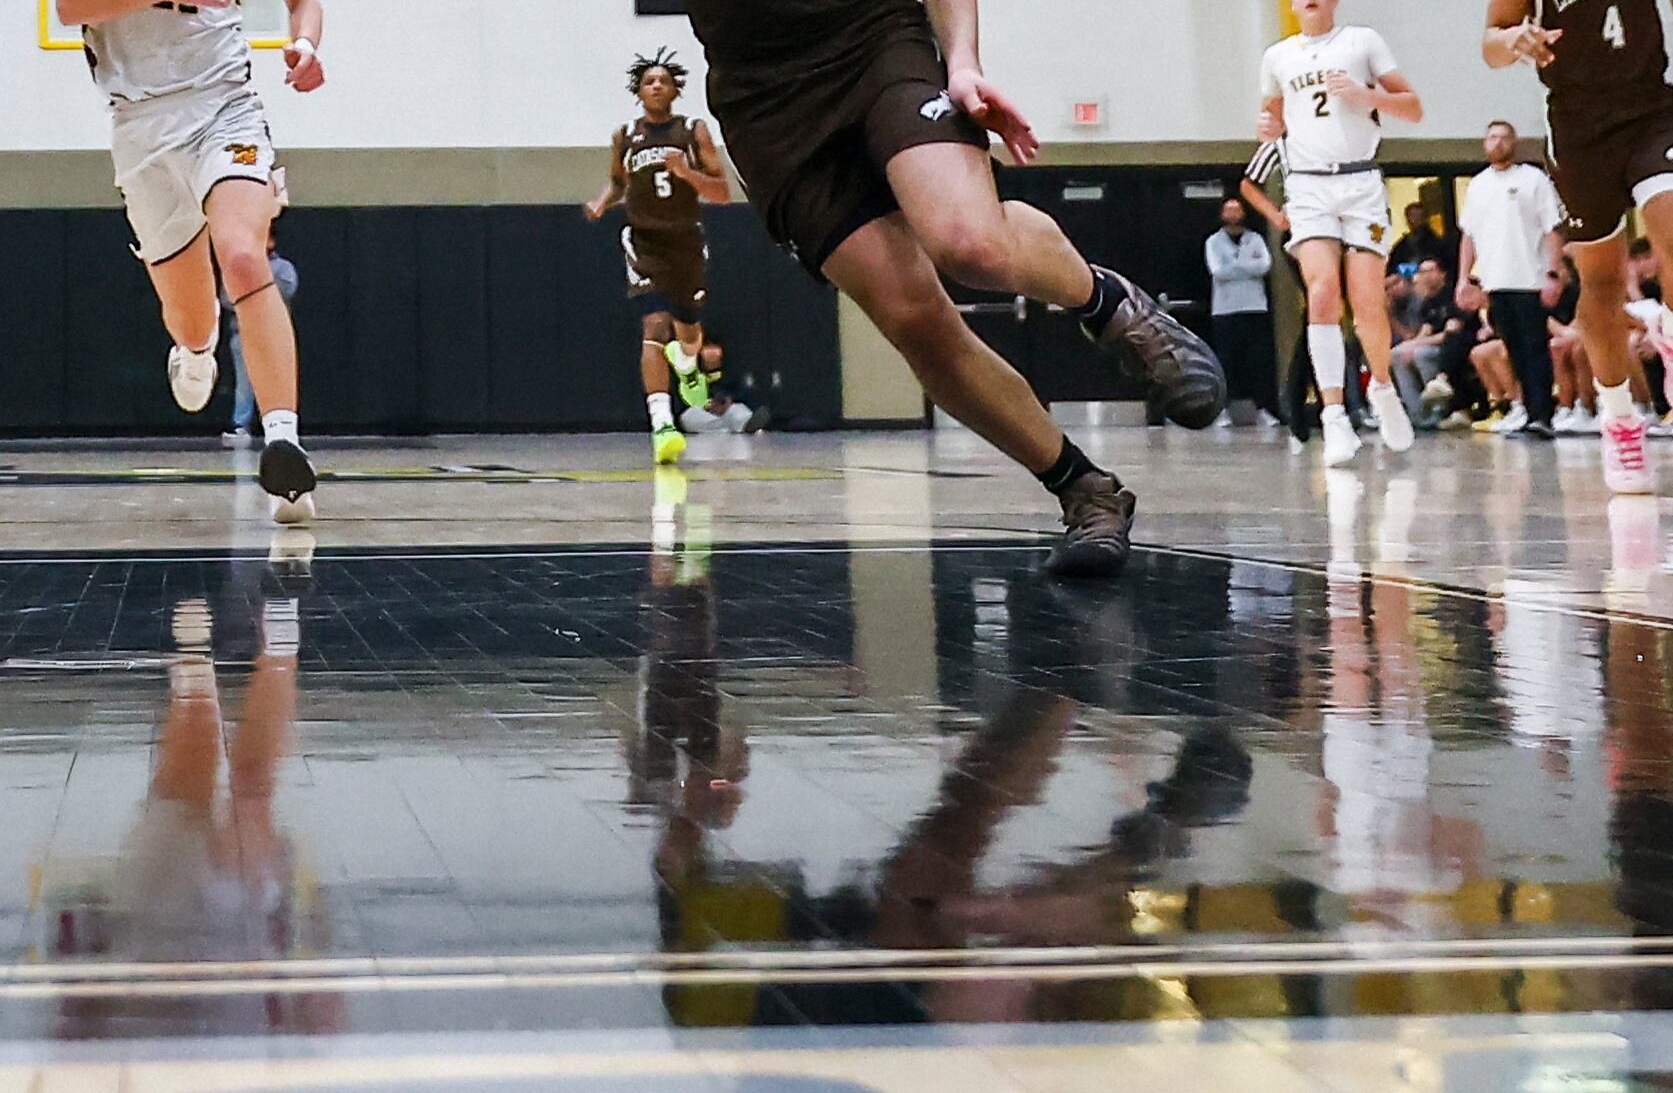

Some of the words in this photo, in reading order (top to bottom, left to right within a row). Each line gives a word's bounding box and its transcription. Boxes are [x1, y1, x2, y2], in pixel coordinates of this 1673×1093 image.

[1602, 4, 1627, 50] 4
[1289, 69, 1347, 92] TIGE
[1312, 90, 1330, 117] 2
[654, 171, 672, 198] 5
